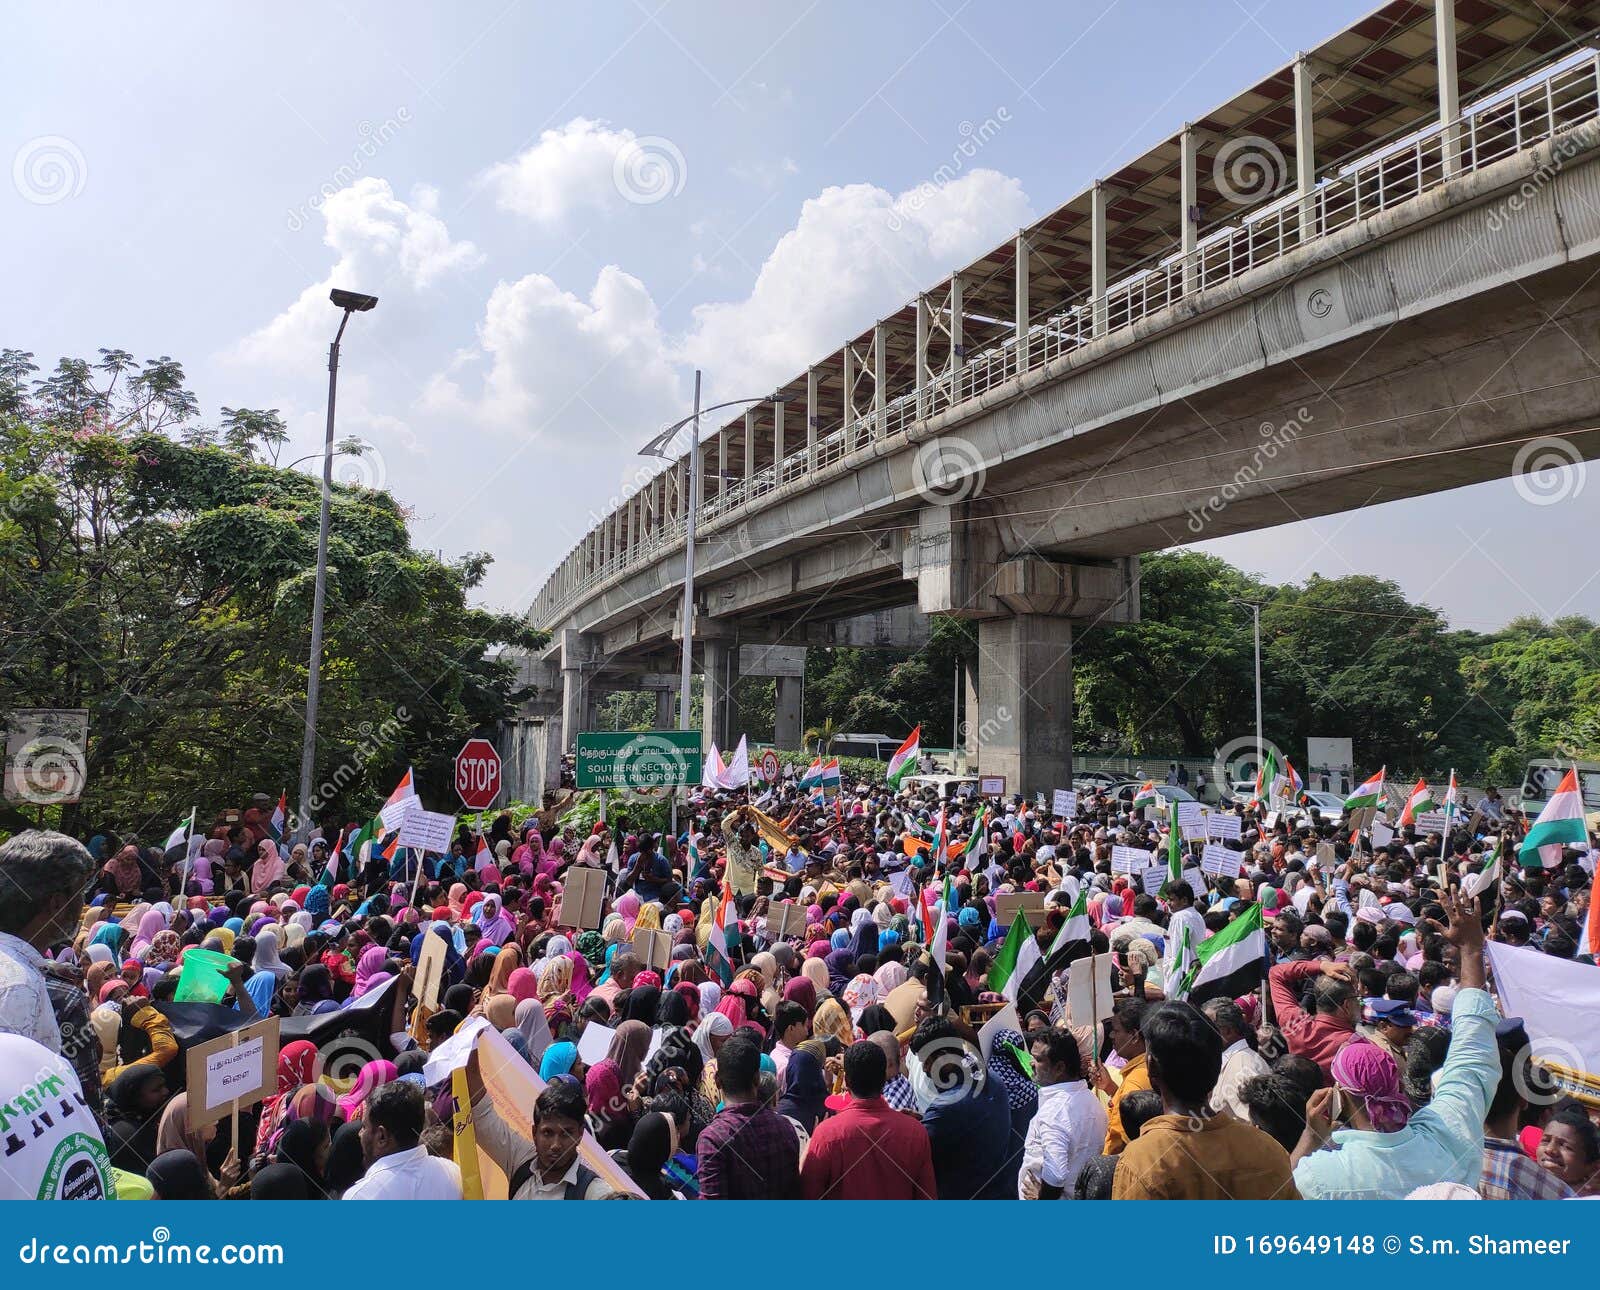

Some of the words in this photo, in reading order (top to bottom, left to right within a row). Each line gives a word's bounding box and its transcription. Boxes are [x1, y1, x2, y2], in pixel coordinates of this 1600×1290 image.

[587, 764, 639, 773] SOUTHERN
[641, 762, 678, 772] SECTOR
[680, 762, 692, 770] OF
[765, 761, 776, 775] 50
[459, 758, 497, 791] STOP
[595, 774, 626, 783] INNER
[629, 773, 654, 782] RING
[656, 772, 685, 781] ROAD
